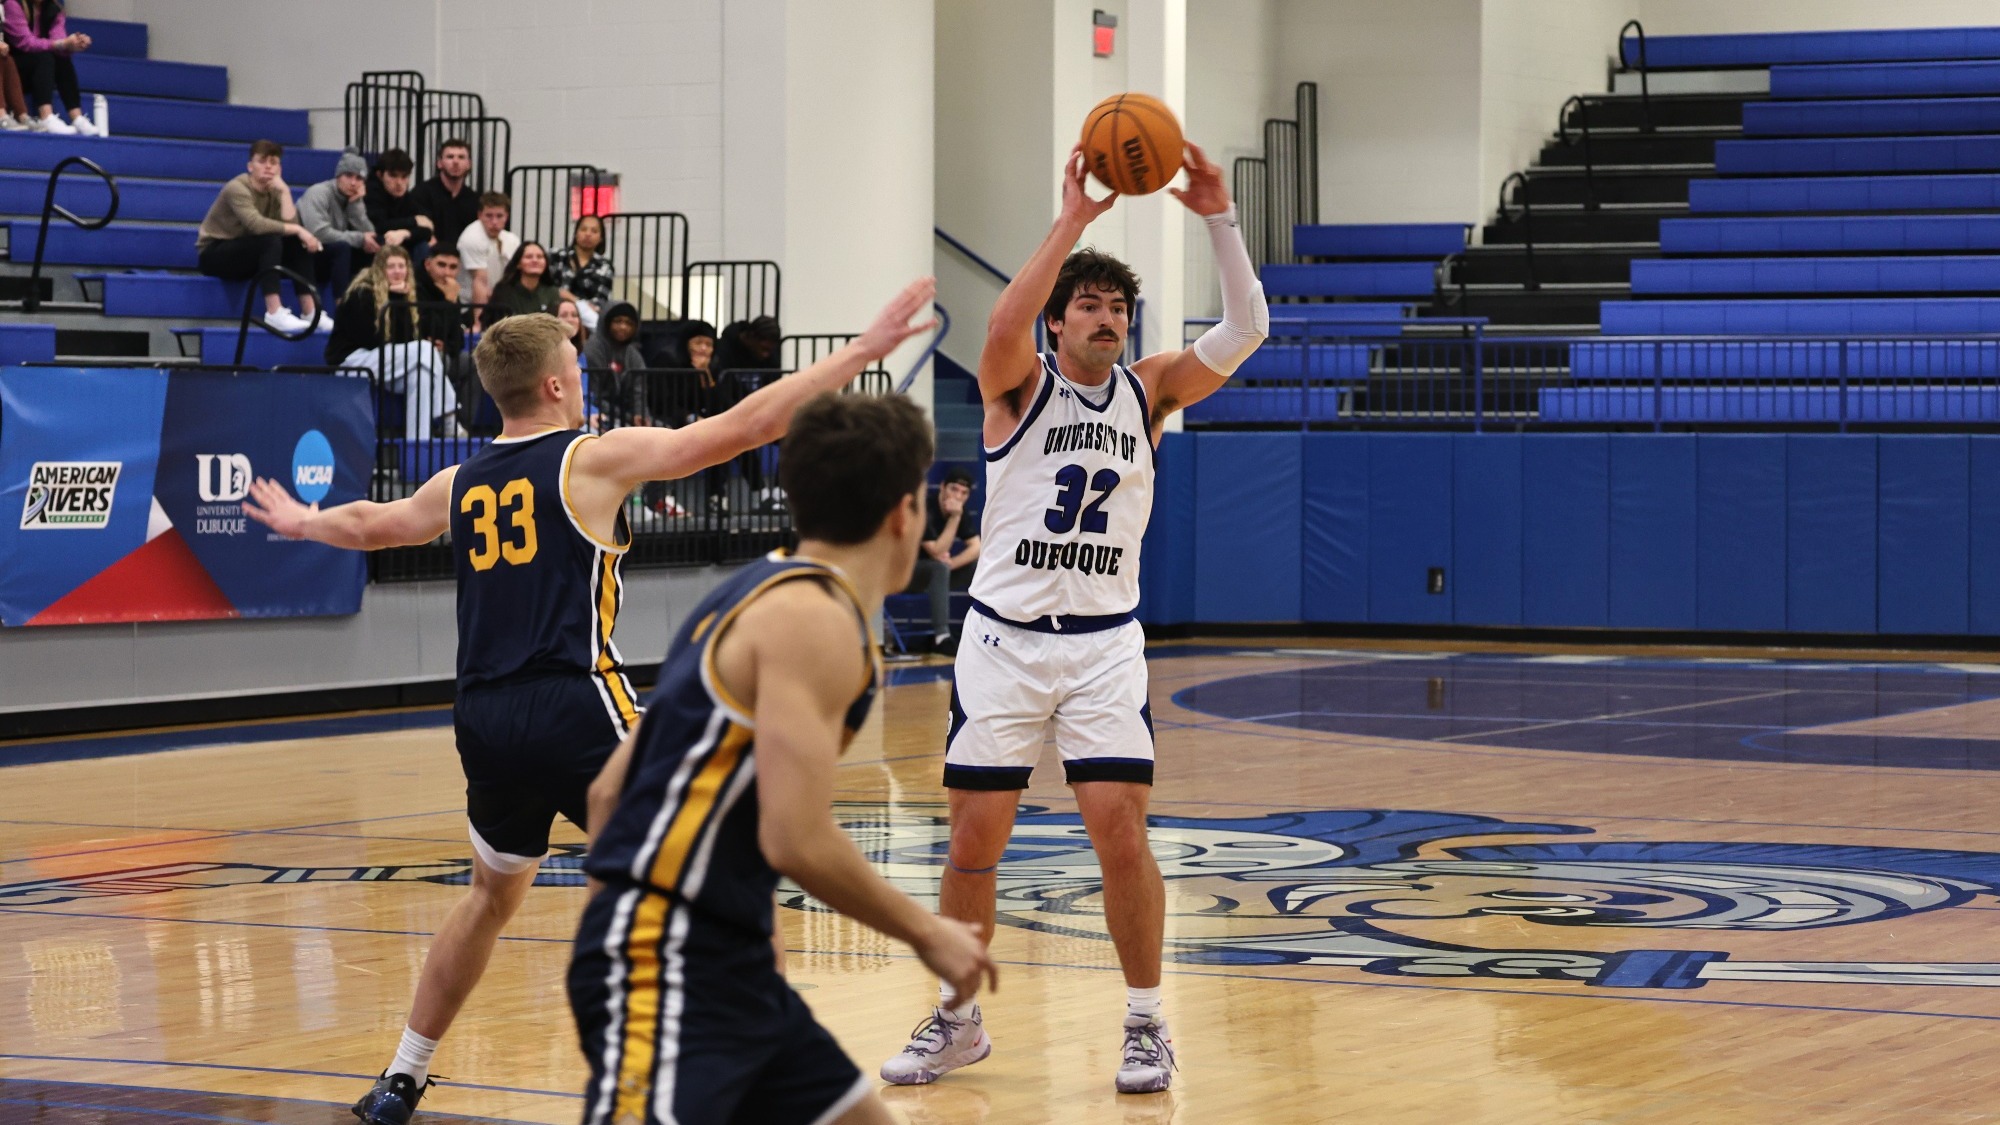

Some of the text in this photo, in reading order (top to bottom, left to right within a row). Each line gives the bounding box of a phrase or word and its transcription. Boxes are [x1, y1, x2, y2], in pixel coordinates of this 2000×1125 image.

[1044, 422, 1137, 463] UNIVERSITY OF
[33, 466, 117, 485] AMERICAN
[296, 465, 334, 485] NCAA
[25, 486, 112, 525] RIVERS
[196, 505, 240, 516] UNIVERSITY
[1044, 464, 1121, 535] 32
[196, 518, 247, 536] DUBUQUE
[460, 477, 539, 572] 33
[1015, 539, 1124, 576] DUBUQUE
